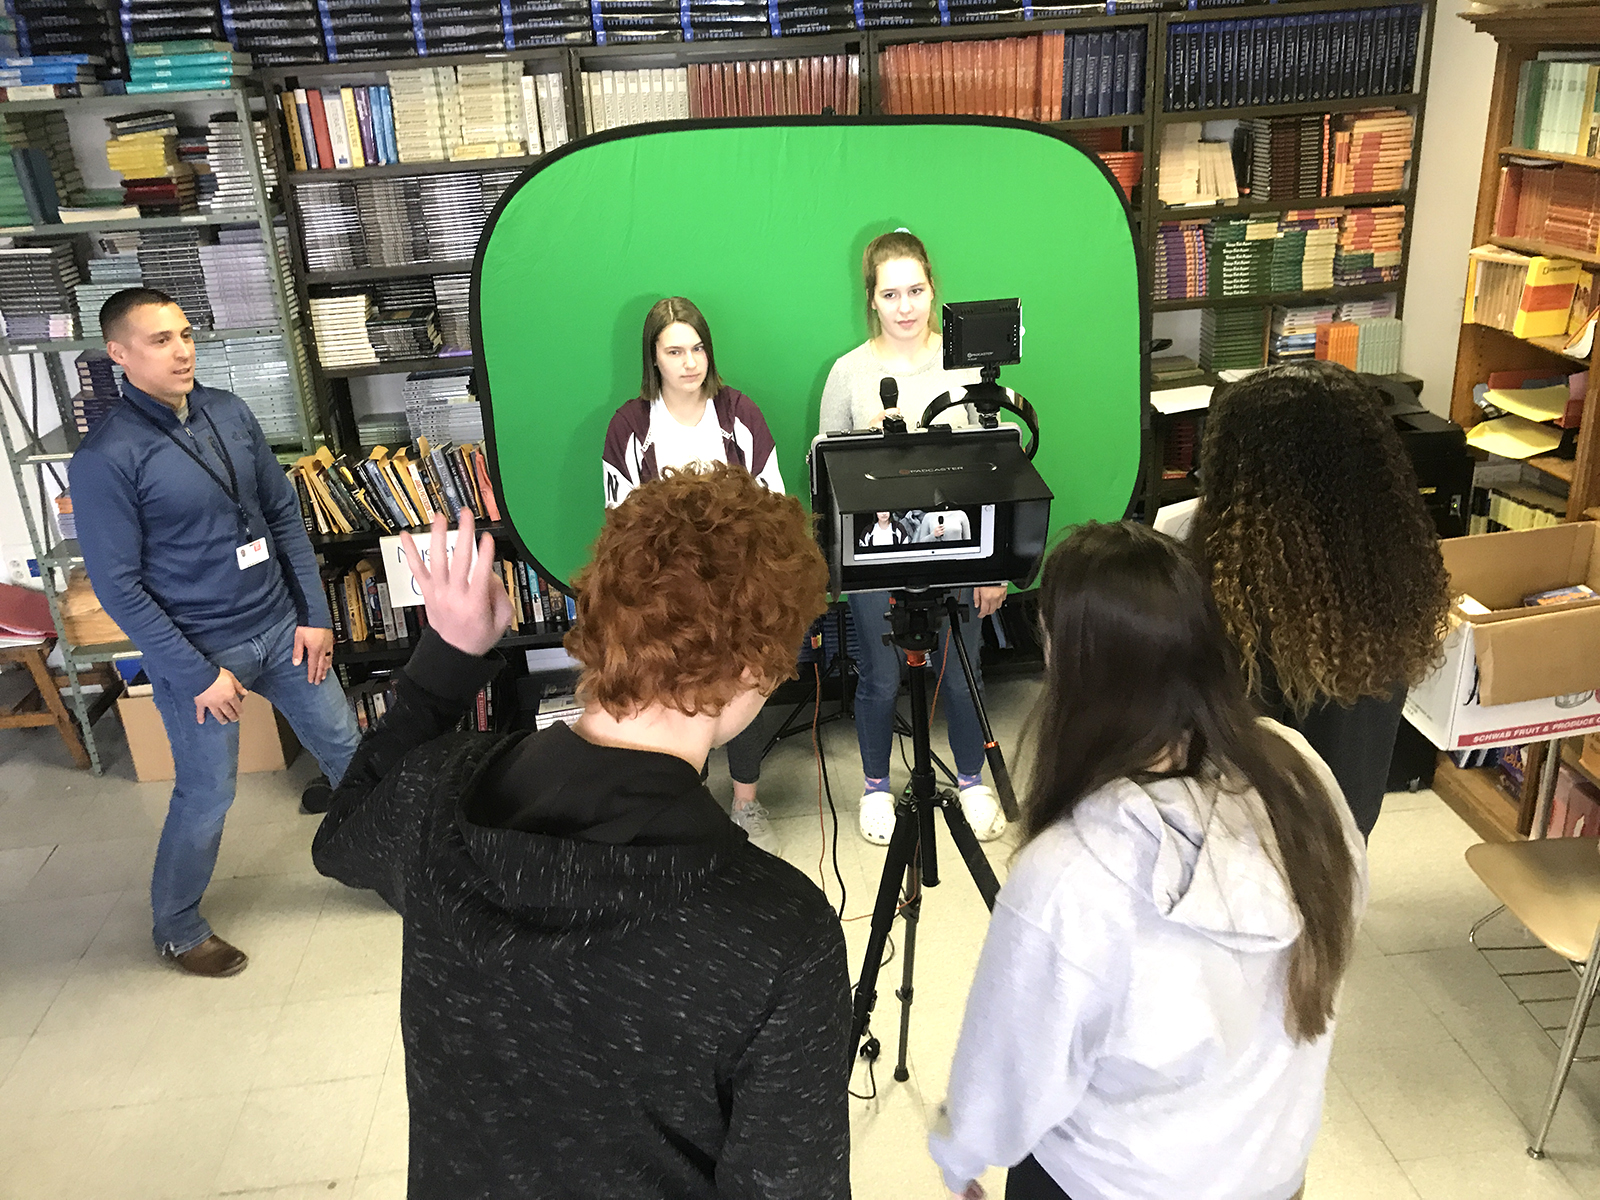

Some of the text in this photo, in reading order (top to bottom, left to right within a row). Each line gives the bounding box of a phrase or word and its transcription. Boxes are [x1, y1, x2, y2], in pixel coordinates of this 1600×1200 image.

[330, 102, 344, 145] LITERATURE
[345, 101, 359, 148] LITERATURE
[294, 153, 301, 161] 2
[1473, 731, 1512, 743] SCHWAB
[1514, 727, 1541, 737] FRUIT
[1552, 717, 1595, 731] PRODUCE
